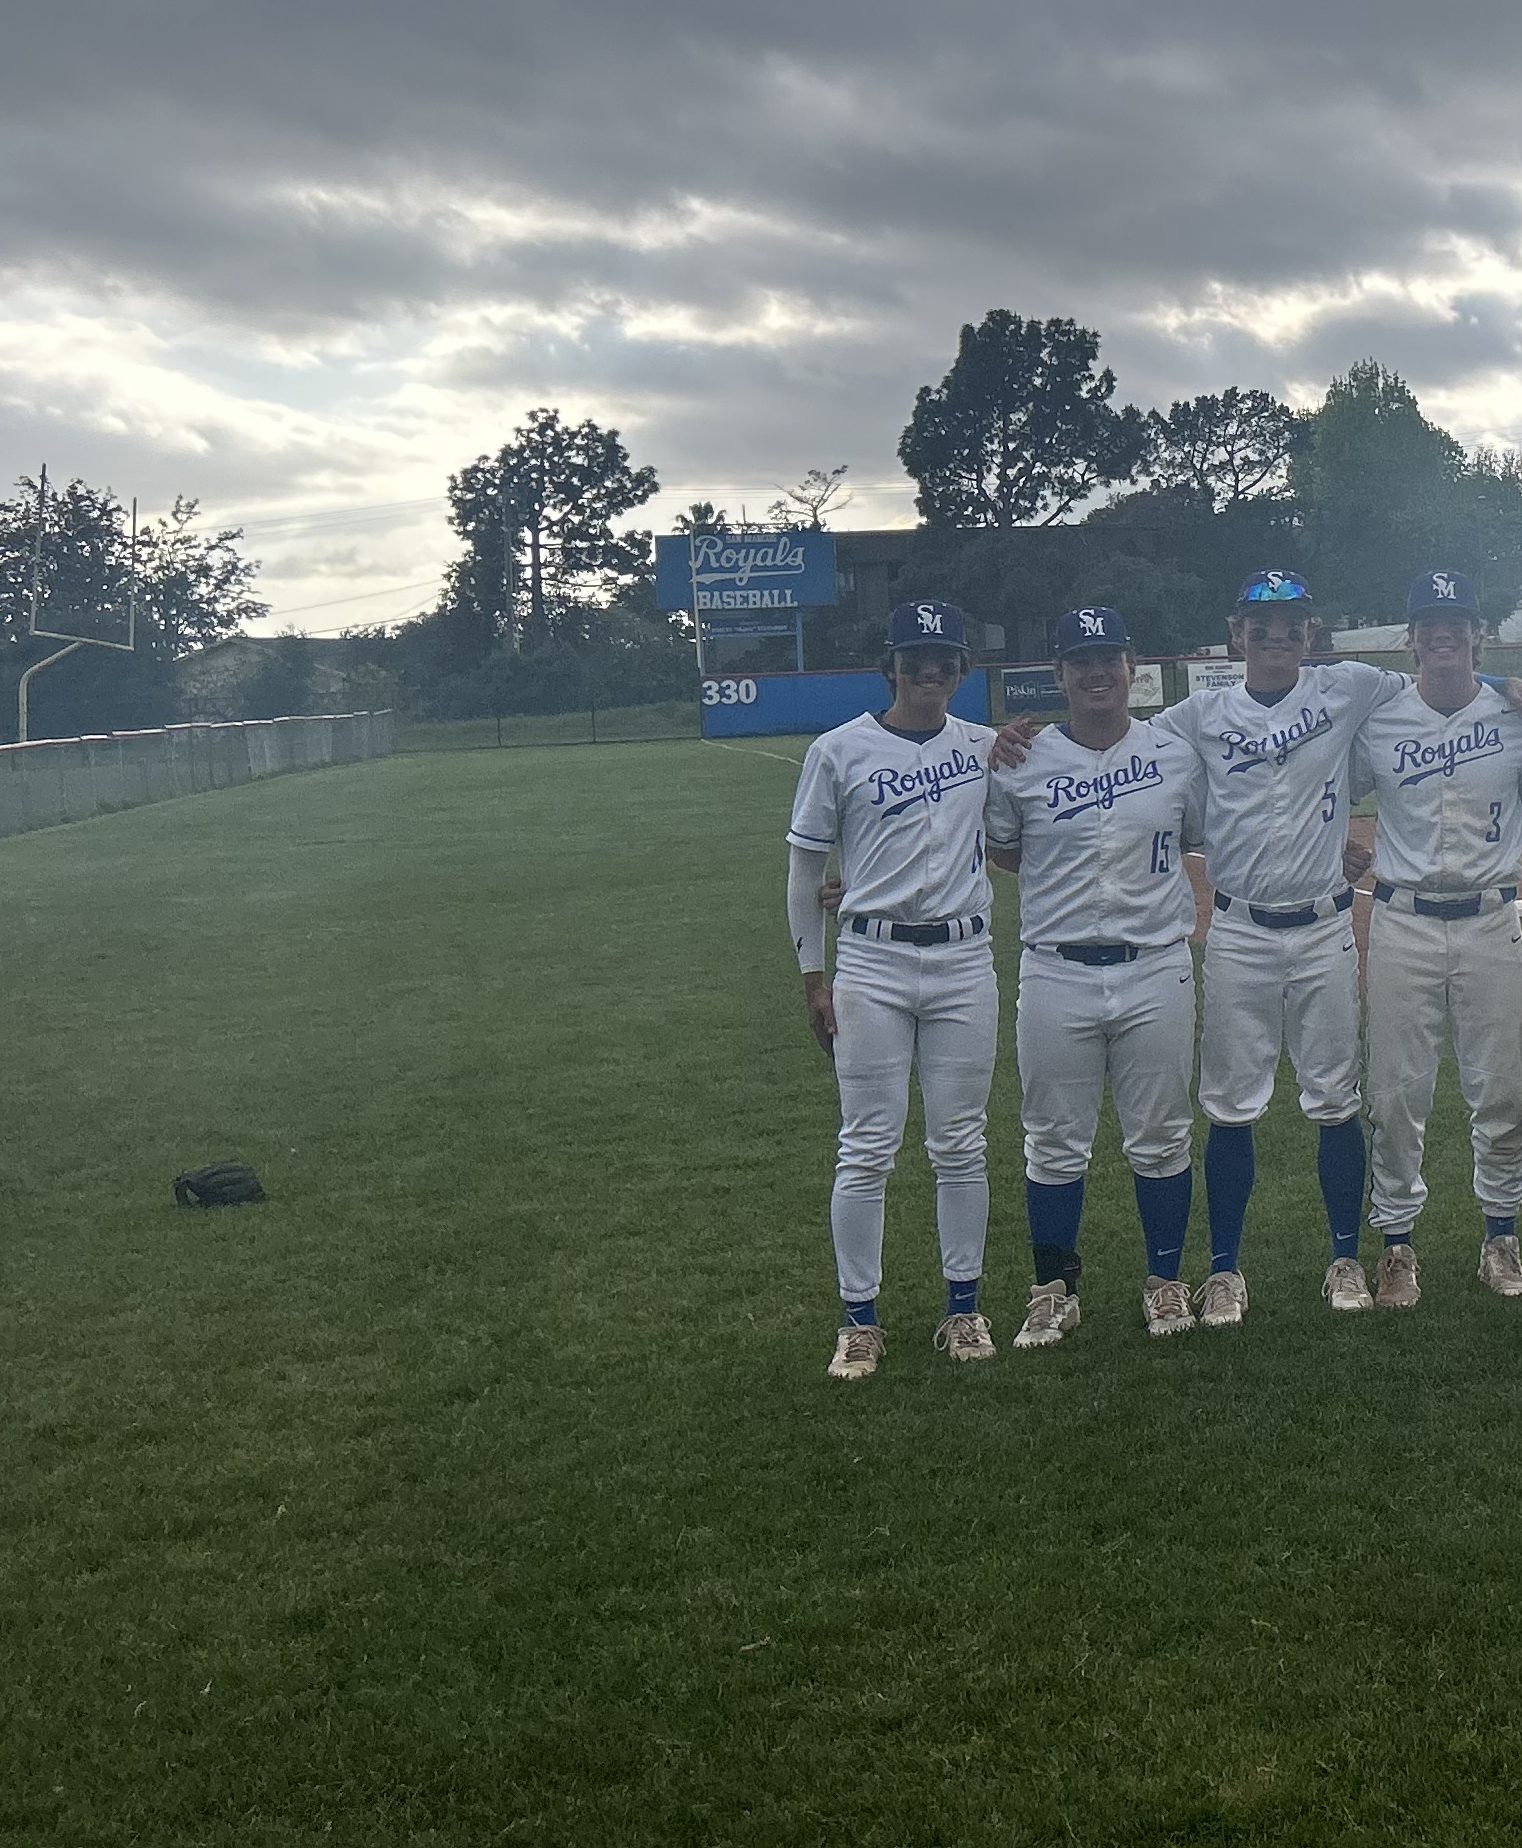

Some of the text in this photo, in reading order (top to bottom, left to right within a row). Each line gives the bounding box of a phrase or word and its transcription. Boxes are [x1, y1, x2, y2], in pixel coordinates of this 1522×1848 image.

[690, 534, 805, 586] Royals
[697, 589, 798, 609] BASEBALL
[1267, 571, 1291, 592] S
[1432, 572, 1456, 600] SM
[917, 605, 943, 634] SM
[1078, 609, 1105, 636] SM
[701, 678, 757, 705] 330
[1195, 674, 1244, 682] STEVENSON
[1219, 707, 1332, 776] Royals
[1393, 721, 1504, 788] Royals
[868, 749, 984, 820] Royals
[1046, 755, 1163, 823] Royals
[1321, 778, 1337, 823] 5
[1485, 802, 1501, 842] 3
[1150, 831, 1173, 873] 15
